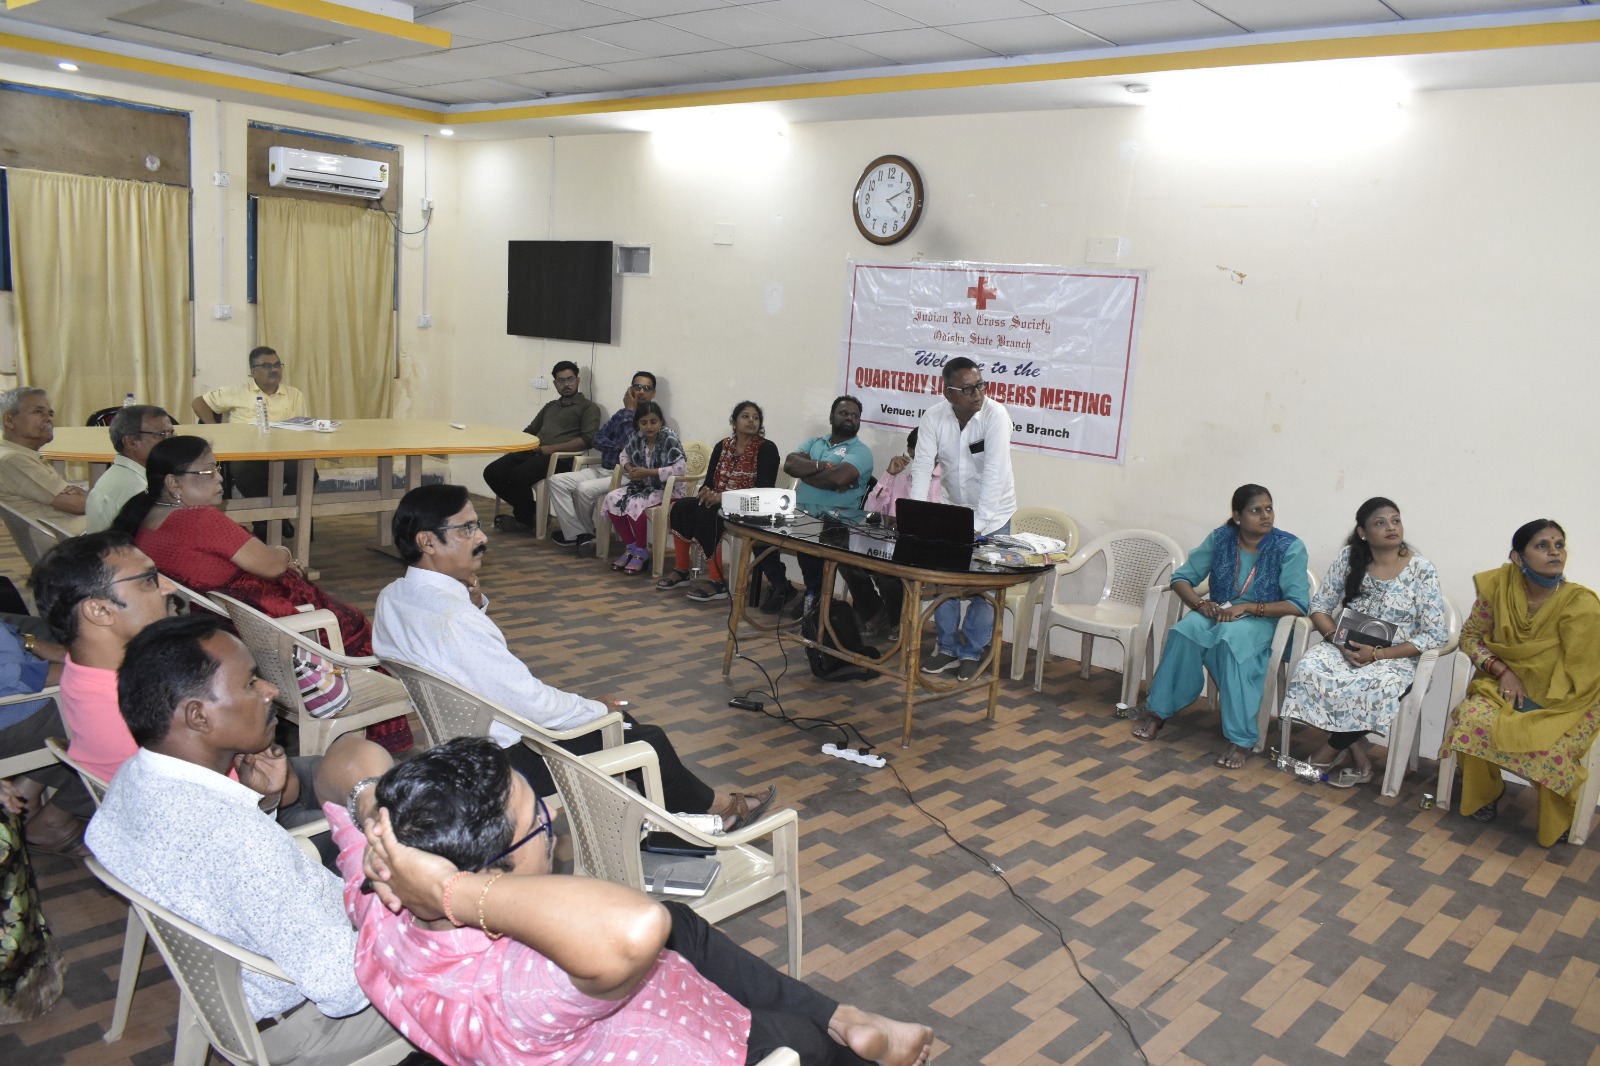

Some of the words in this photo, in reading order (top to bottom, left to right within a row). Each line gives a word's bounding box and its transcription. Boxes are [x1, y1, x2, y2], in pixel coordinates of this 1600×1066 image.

[878, 170, 883, 181] 11
[888, 168, 896, 179] 12
[900, 172, 904, 183] 1
[869, 180, 875, 191] 10
[905, 182, 912, 193] 2
[865, 193, 870, 205] 9
[906, 197, 912, 208] 3
[865, 207, 871, 218] 8
[902, 211, 906, 222] 4
[873, 219, 877, 230] 7
[882, 223, 887, 234] 6
[893, 220, 898, 231] 5
[913, 309, 948, 324] Indian
[953, 311, 971, 326] Red
[976, 313, 1006, 327] Cross
[1009, 315, 1051, 335] Society
[933, 330, 965, 345] Odisha
[969, 332, 993, 346] State
[997, 334, 1031, 352] Branch
[915, 350, 985, 372] Wele
[990, 362, 1008, 374] to
[1013, 361, 1041, 378] the
[855, 366, 929, 394] QUARTERLY
[982, 381, 1036, 408] MBERS
[1039, 387, 1112, 417] MEETING
[880, 403, 915, 417] Venue:
[1026, 423, 1070, 438] Branch
